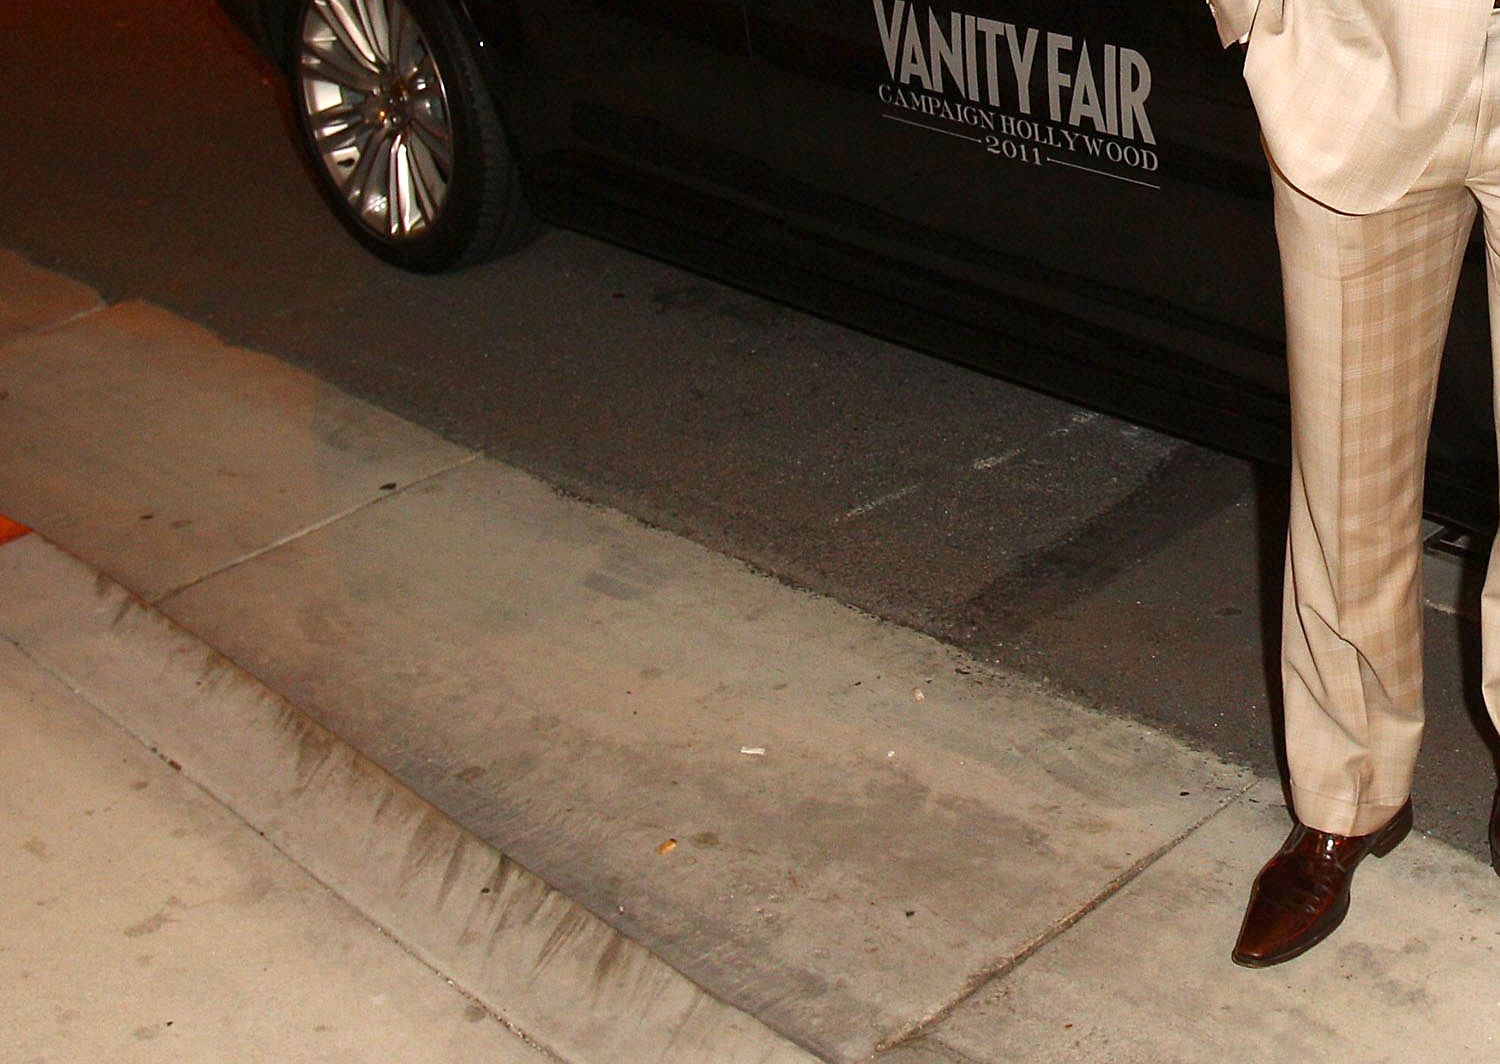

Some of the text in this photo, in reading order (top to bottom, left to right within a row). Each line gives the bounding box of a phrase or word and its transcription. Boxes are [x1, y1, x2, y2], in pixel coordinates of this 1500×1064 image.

[878, 82, 1159, 171] CAMPAIGN HOLLYWOOD
[1047, 32, 1157, 145] FAIR
[985, 136, 1042, 165] 2011
